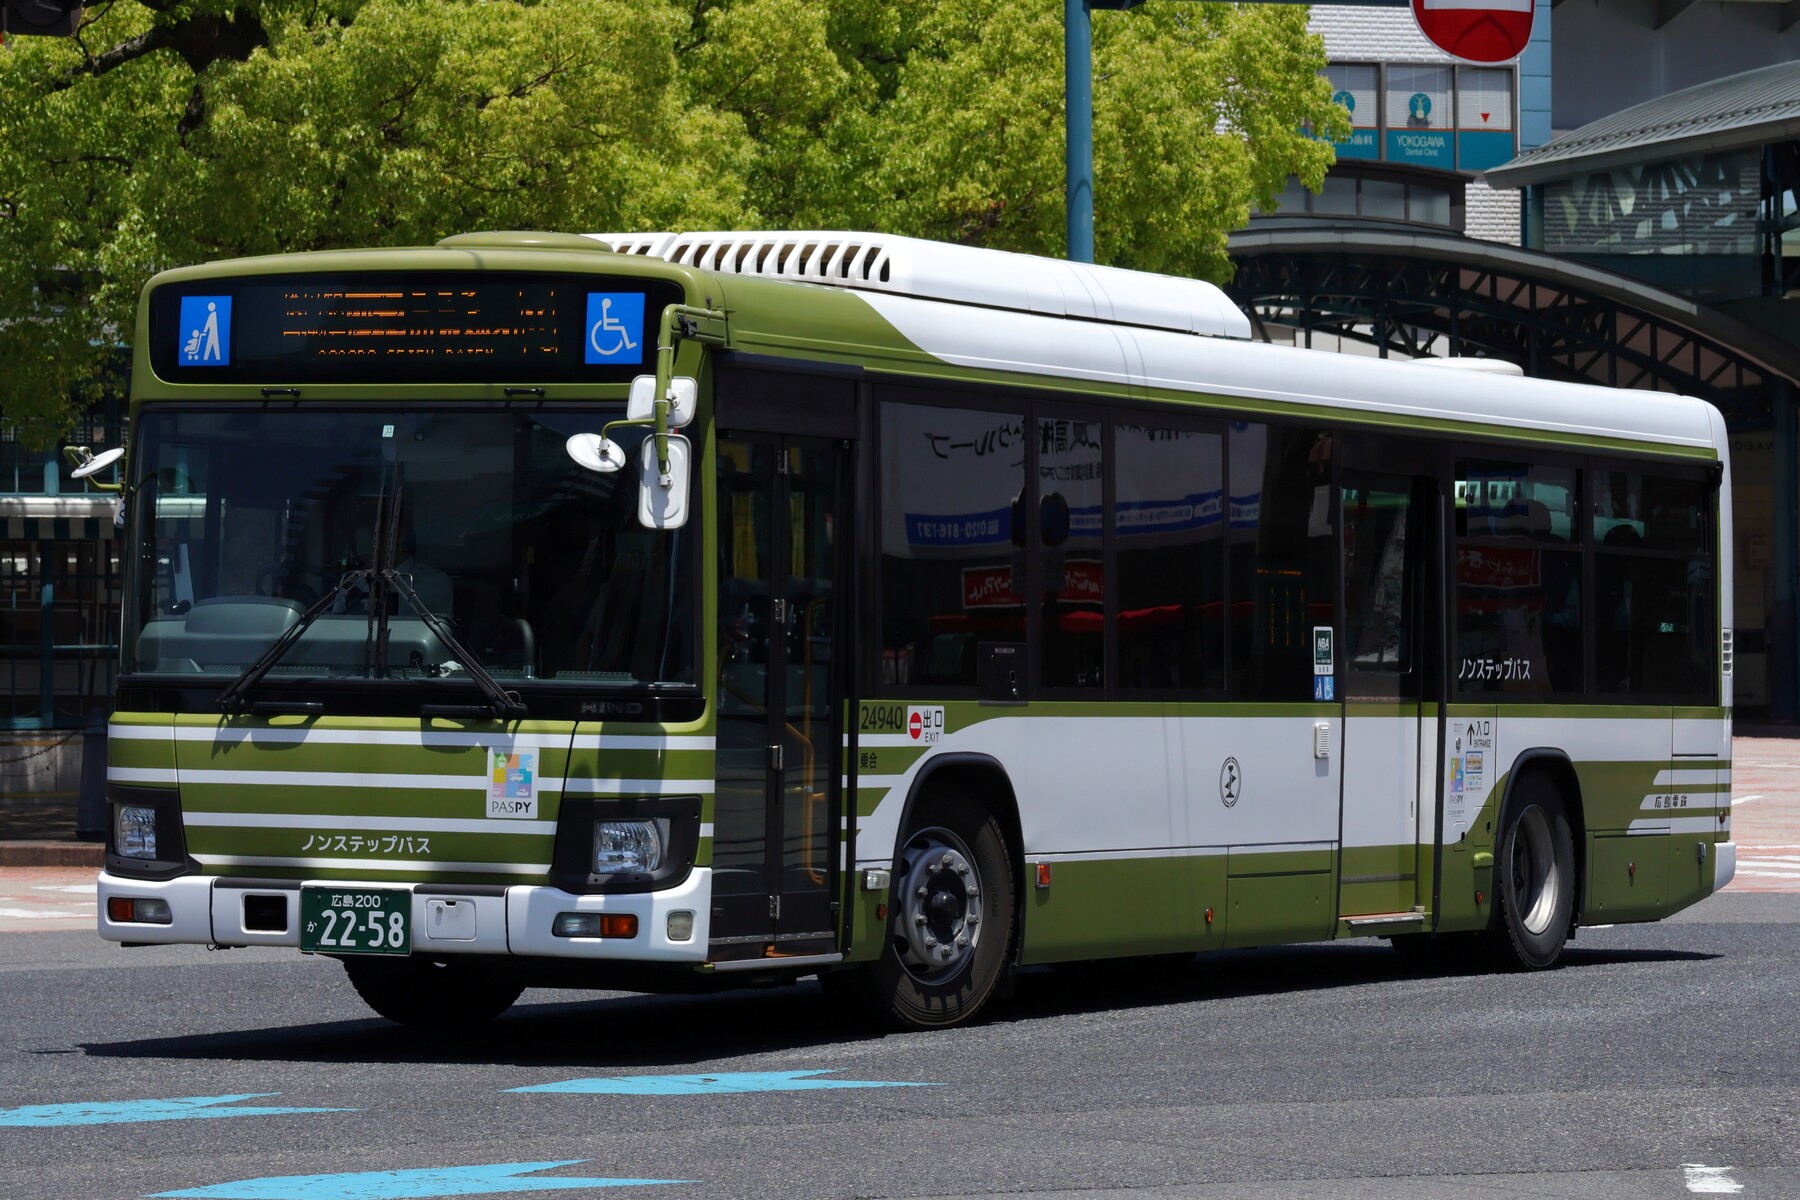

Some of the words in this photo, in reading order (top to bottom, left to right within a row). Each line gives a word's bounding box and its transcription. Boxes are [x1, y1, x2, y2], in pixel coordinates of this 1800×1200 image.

[1396, 135, 1445, 148] YOKOGAWA
[1405, 148, 1423, 156] Dental
[1424, 148, 1439, 157] Clinic
[1317, 637, 1330, 650] NBA
[1458, 657, 1532, 682] ノンステップバス
[579, 701, 643, 714] HINO
[861, 705, 903, 730] 24940
[922, 709, 943, 729] 出口
[1475, 721, 1490, 737] 入口
[924, 732, 940, 743] EXIT
[1474, 739, 1491, 749] ENTRANCE
[860, 752, 878, 770] 乗合
[492, 801, 532, 813] PASPY
[301, 834, 431, 855] ノンステップバス
[306, 921, 318, 933] か
[320, 910, 405, 948] 22-58
